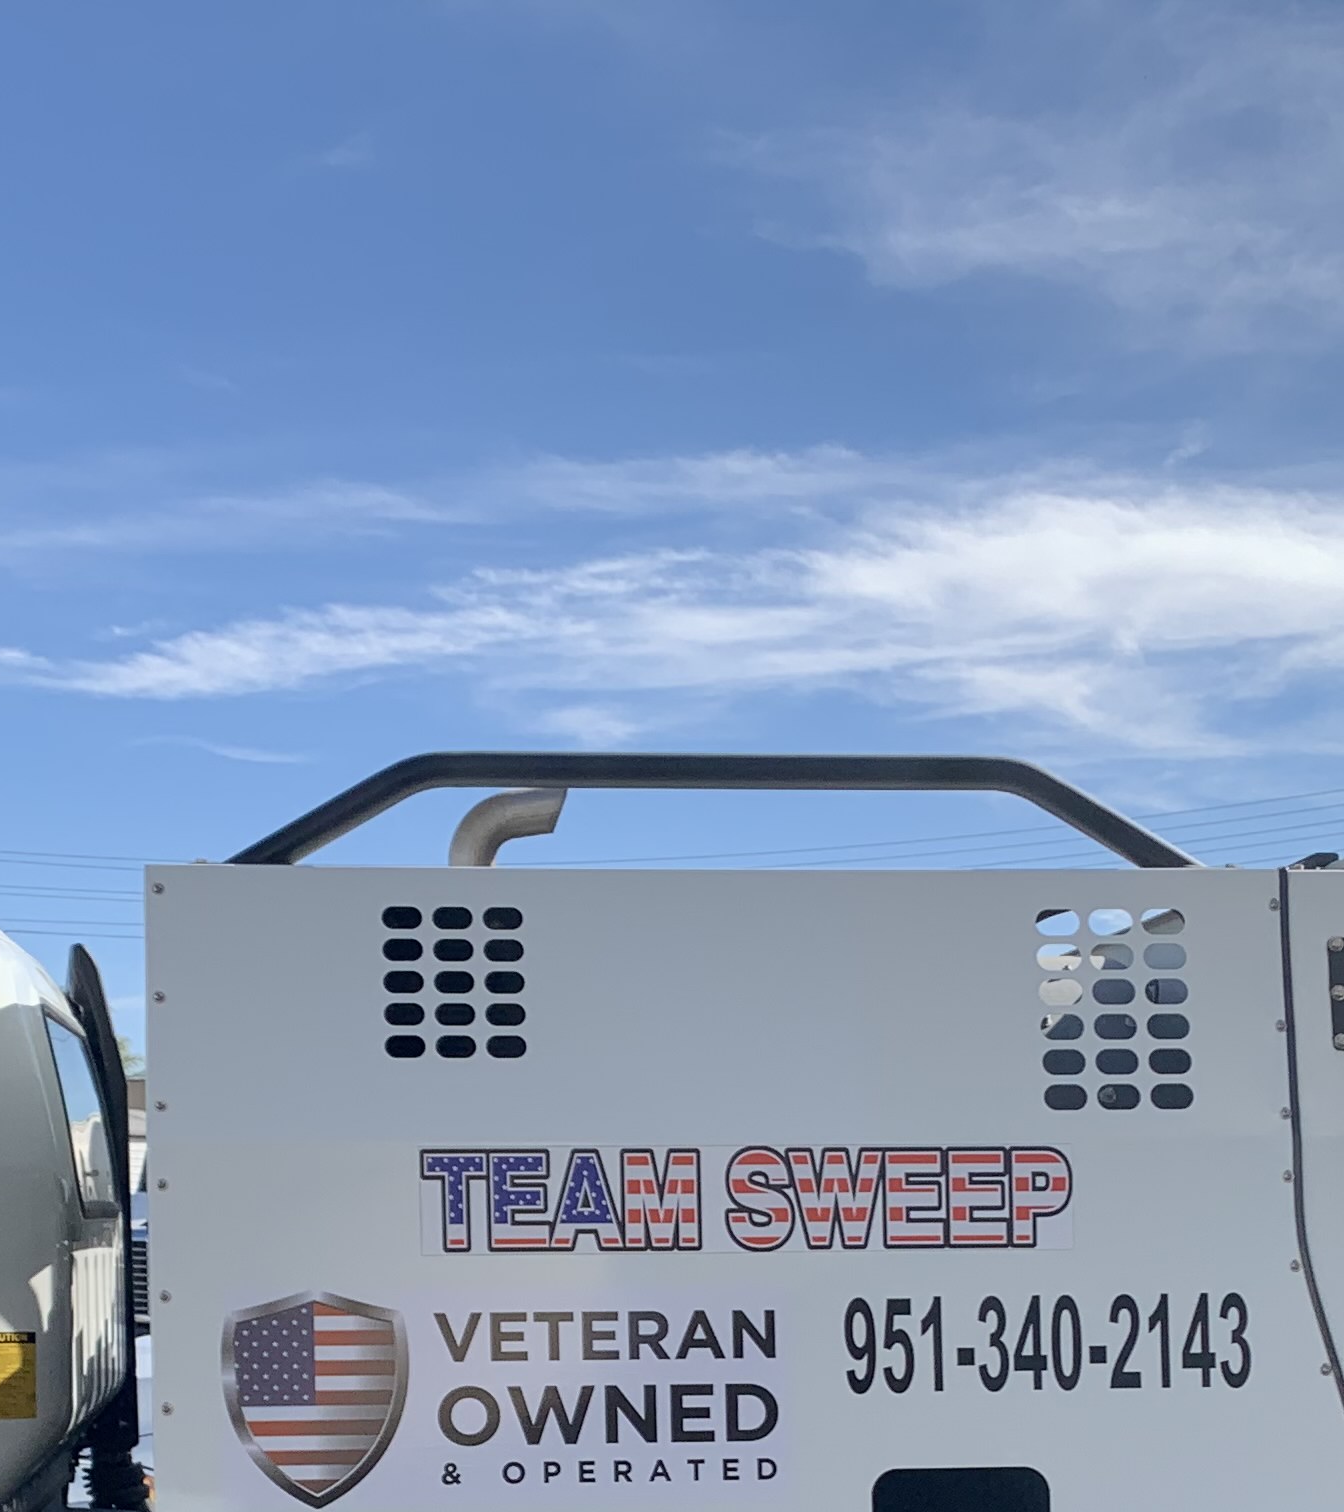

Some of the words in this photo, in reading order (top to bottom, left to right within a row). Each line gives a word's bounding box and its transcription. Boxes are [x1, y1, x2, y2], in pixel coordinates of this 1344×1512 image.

[422, 1147, 702, 1251] TEAM
[725, 1146, 1072, 1251] SWEEP
[434, 1310, 776, 1362] VETERAN
[845, 1293, 1251, 1394] 951-340-2143
[438, 1384, 778, 1446] OWNED
[442, 1463, 461, 1485] &
[503, 1458, 777, 1485] OPERATED
